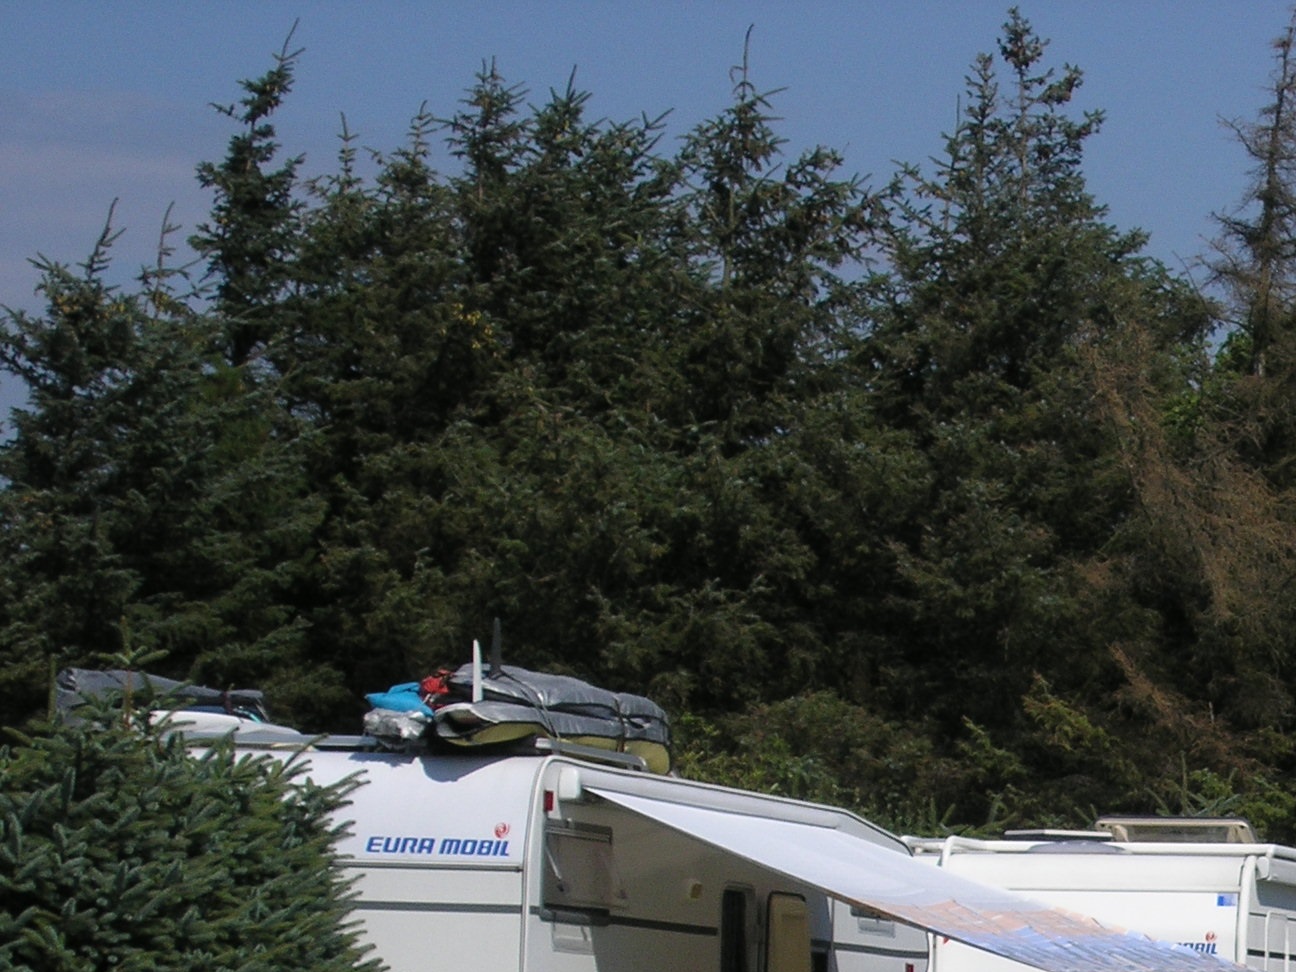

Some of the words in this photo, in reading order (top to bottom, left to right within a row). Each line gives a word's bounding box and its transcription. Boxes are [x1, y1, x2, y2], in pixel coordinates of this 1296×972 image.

[365, 836, 436, 854] EURA
[438, 838, 510, 857] MOBIL
[1177, 942, 1219, 955] BIL
